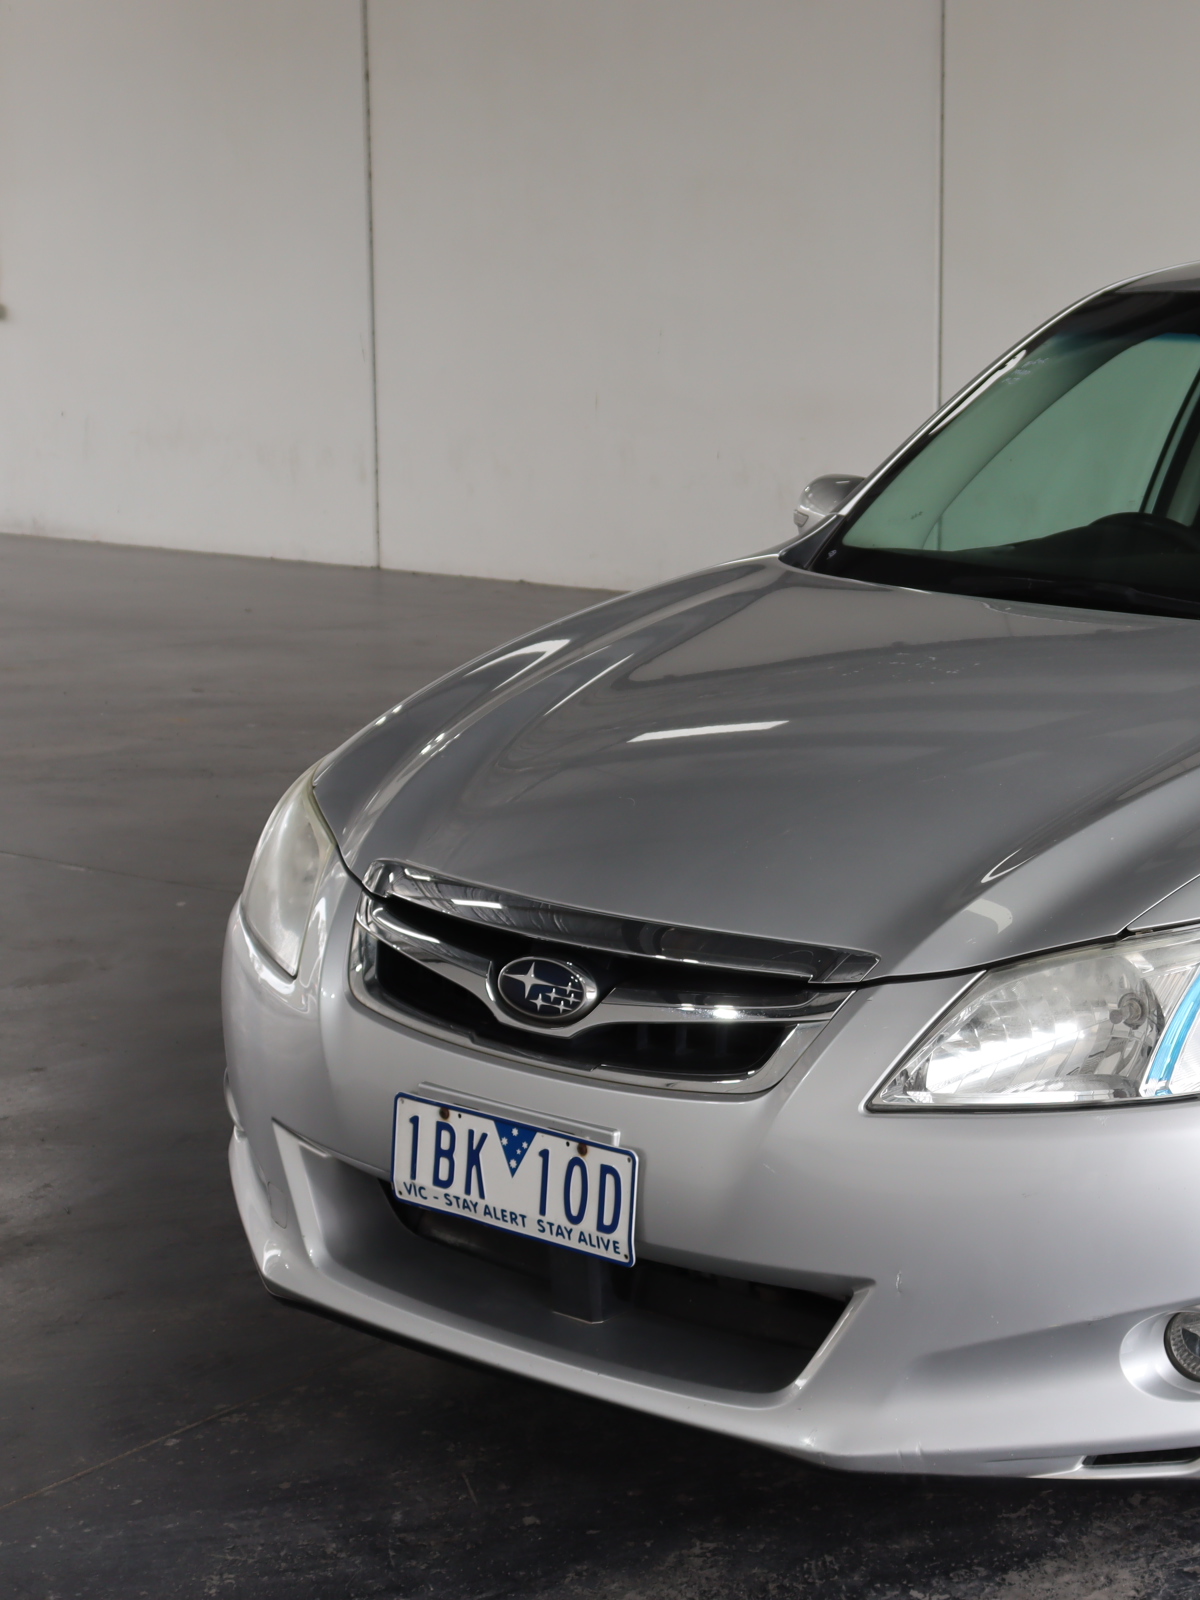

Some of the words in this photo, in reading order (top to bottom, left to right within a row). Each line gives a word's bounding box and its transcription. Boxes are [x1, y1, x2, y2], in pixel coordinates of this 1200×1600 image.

[409, 1115, 488, 1200] 1BK
[403, 1181, 428, 1200] VIC
[444, 1192, 479, 1215] STAY
[483, 1203, 528, 1228] ALERT
[537, 1218, 573, 1242] STAY
[578, 1231, 621, 1255] ALIVE
